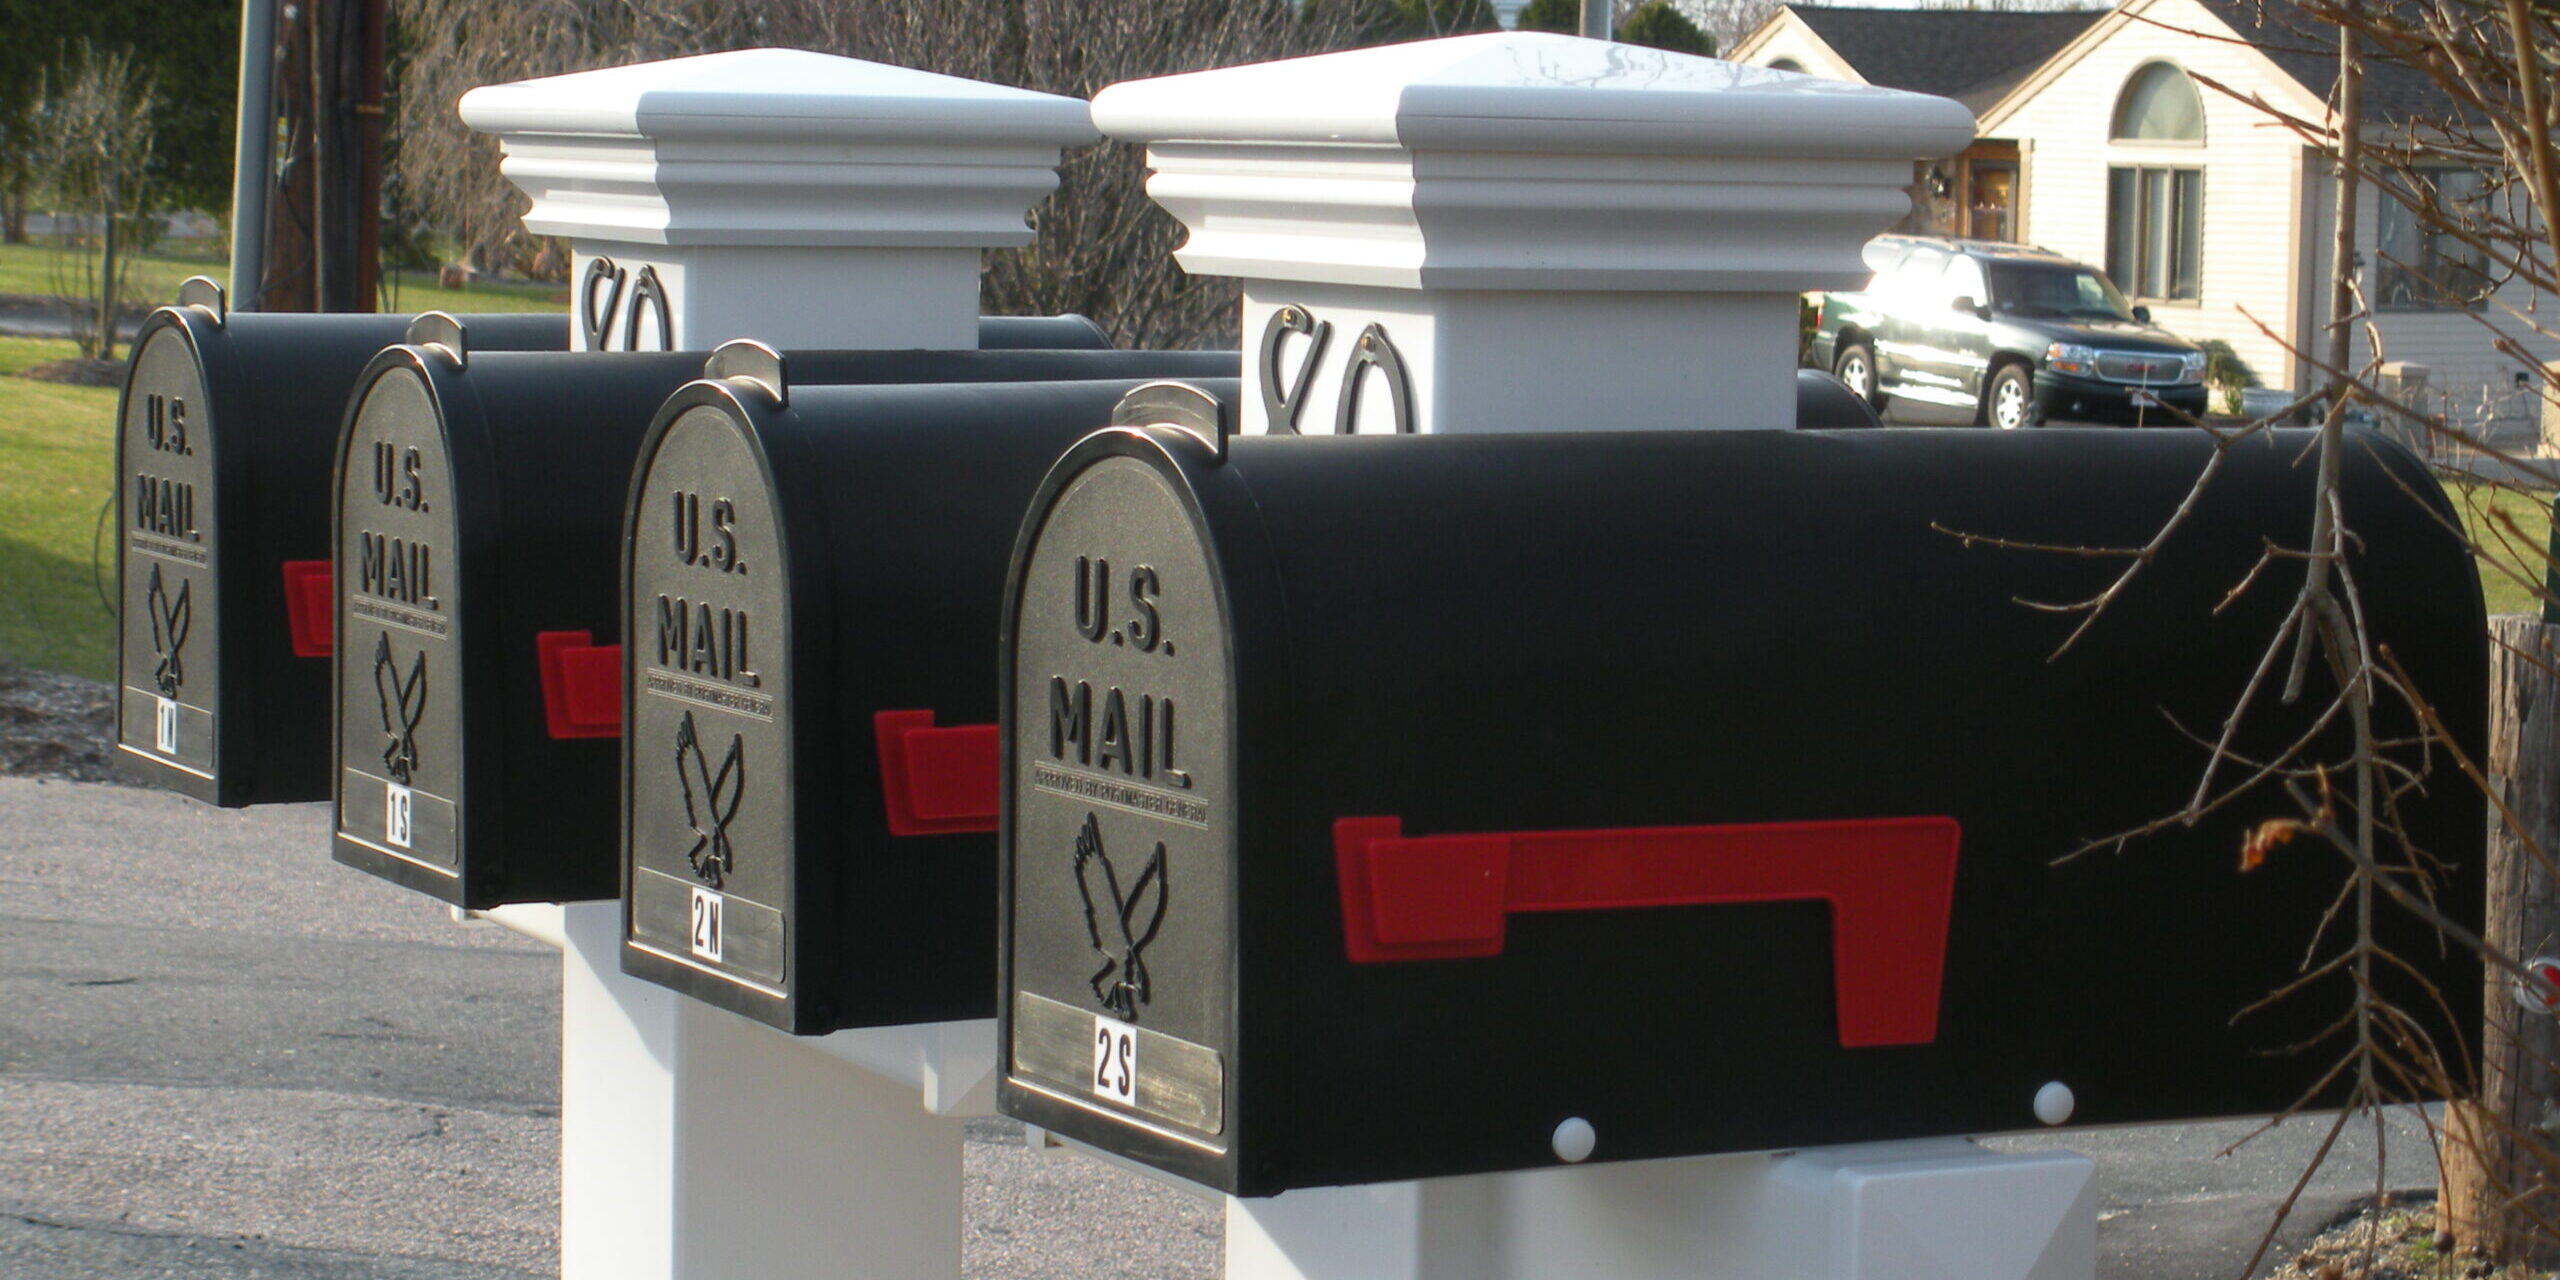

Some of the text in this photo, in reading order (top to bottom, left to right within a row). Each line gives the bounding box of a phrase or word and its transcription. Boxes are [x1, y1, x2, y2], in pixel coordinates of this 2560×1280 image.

[147, 393, 193, 456] U.S.
[137, 473, 200, 542] MAIL
[373, 440, 429, 513] U.S.
[359, 528, 439, 611] MAIL
[672, 488, 748, 576] U.S.
[656, 592, 761, 688] MAIL
[1074, 554, 1176, 657] U.S.
[1049, 673, 1193, 790] MAIL
